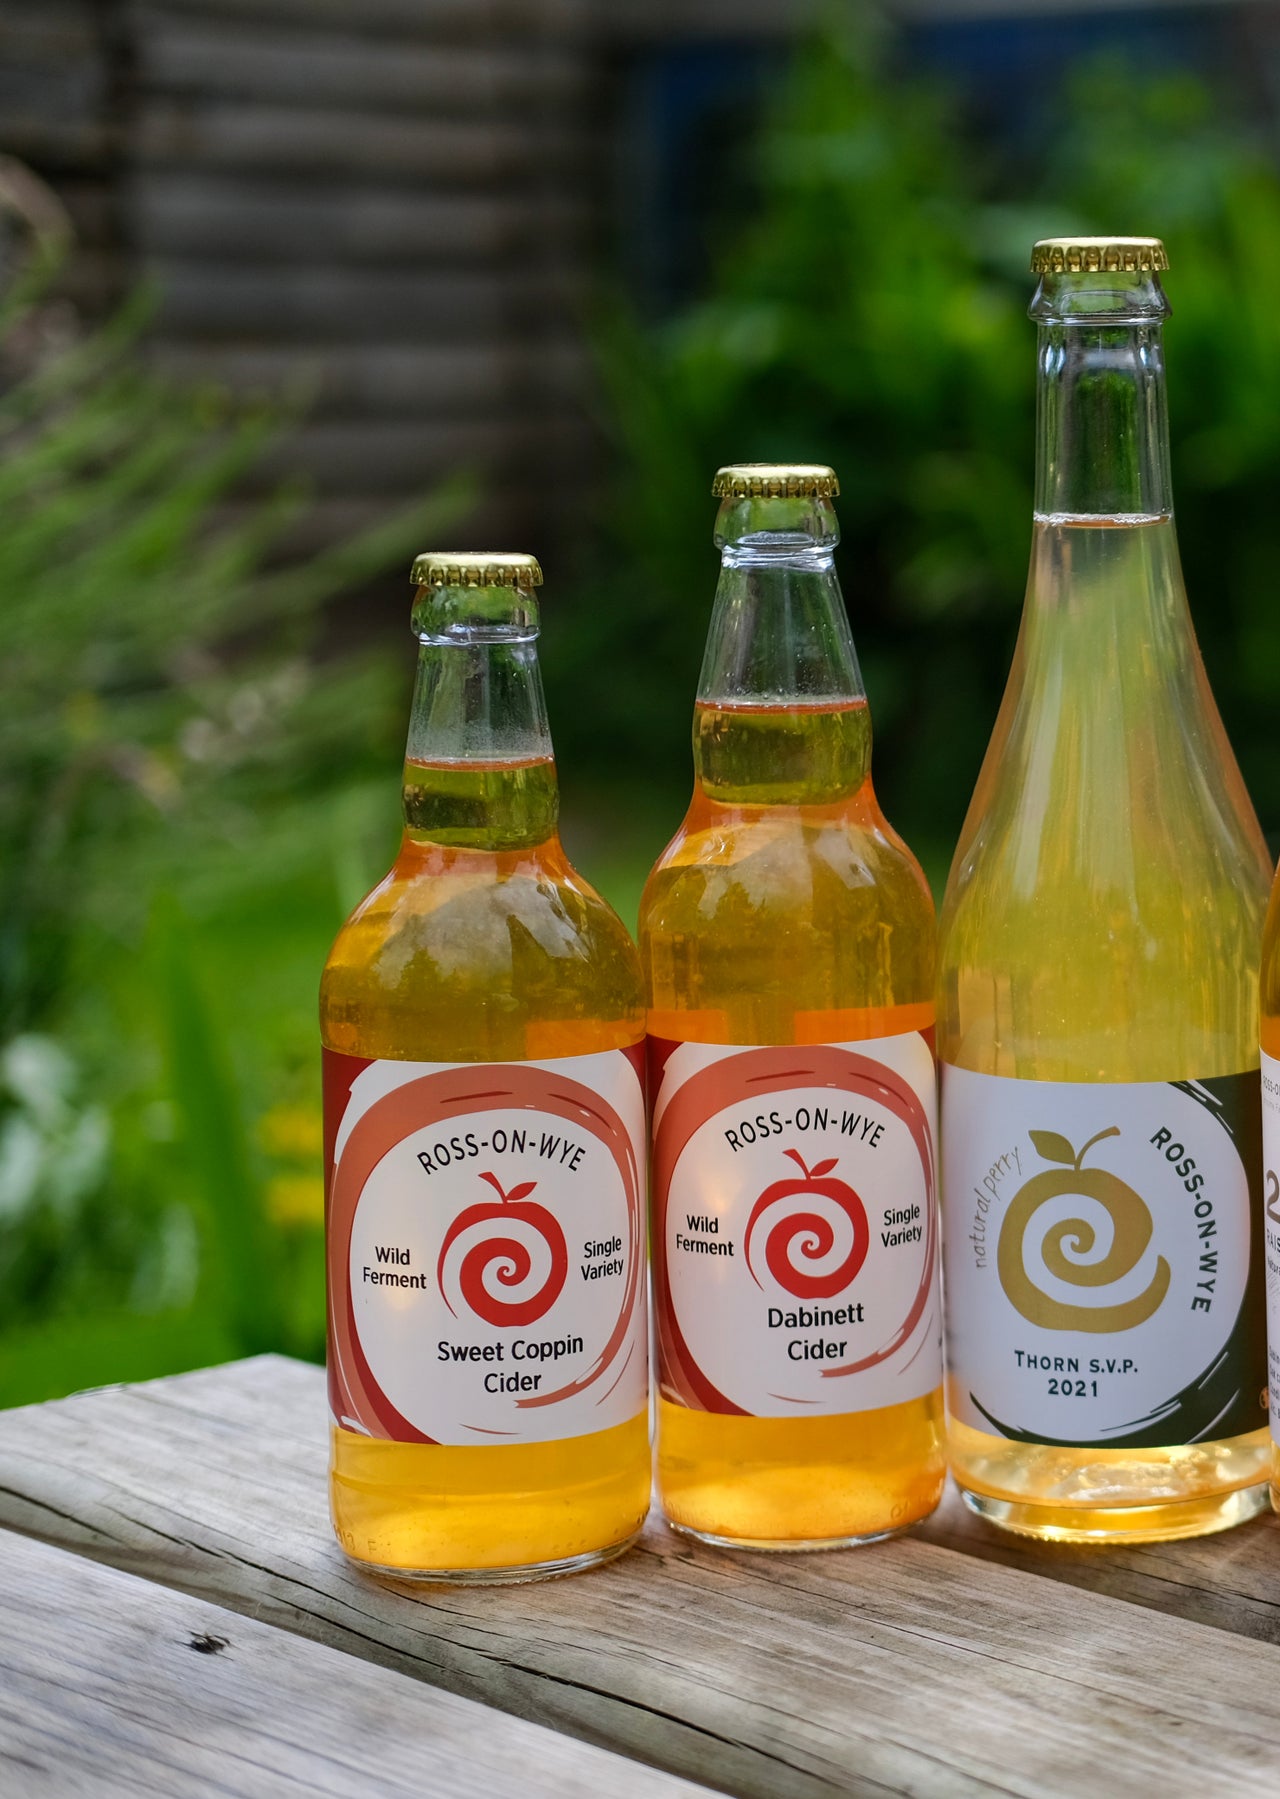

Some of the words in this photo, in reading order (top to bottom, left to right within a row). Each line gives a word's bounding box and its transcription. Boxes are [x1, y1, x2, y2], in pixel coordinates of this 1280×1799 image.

[724, 1107, 885, 1152] ROSS-ON-WYE
[417, 1129, 586, 1175] ROSS-ON-WYE
[883, 1204, 920, 1227] Single
[968, 1187, 992, 1271] natural
[982, 1146, 1023, 1201] perry
[1149, 1126, 1219, 1314] ROSS-ON-WYE
[686, 1214, 719, 1234] Wild
[583, 1235, 622, 1259] Single
[676, 1234, 734, 1257] Ferment
[881, 1225, 923, 1248] Variety
[375, 1246, 410, 1266] Wild
[363, 1267, 427, 1290] Ferment
[581, 1258, 624, 1281] Variety
[768, 1303, 864, 1328] Dabinett
[437, 1341, 504, 1362] Sweet
[511, 1335, 584, 1362] Coppin
[787, 1339, 847, 1361] Cider
[1089, 1358, 1139, 1374] S.V.P.
[484, 1372, 542, 1394] Cider
[1047, 1378, 1099, 1398] 2021
